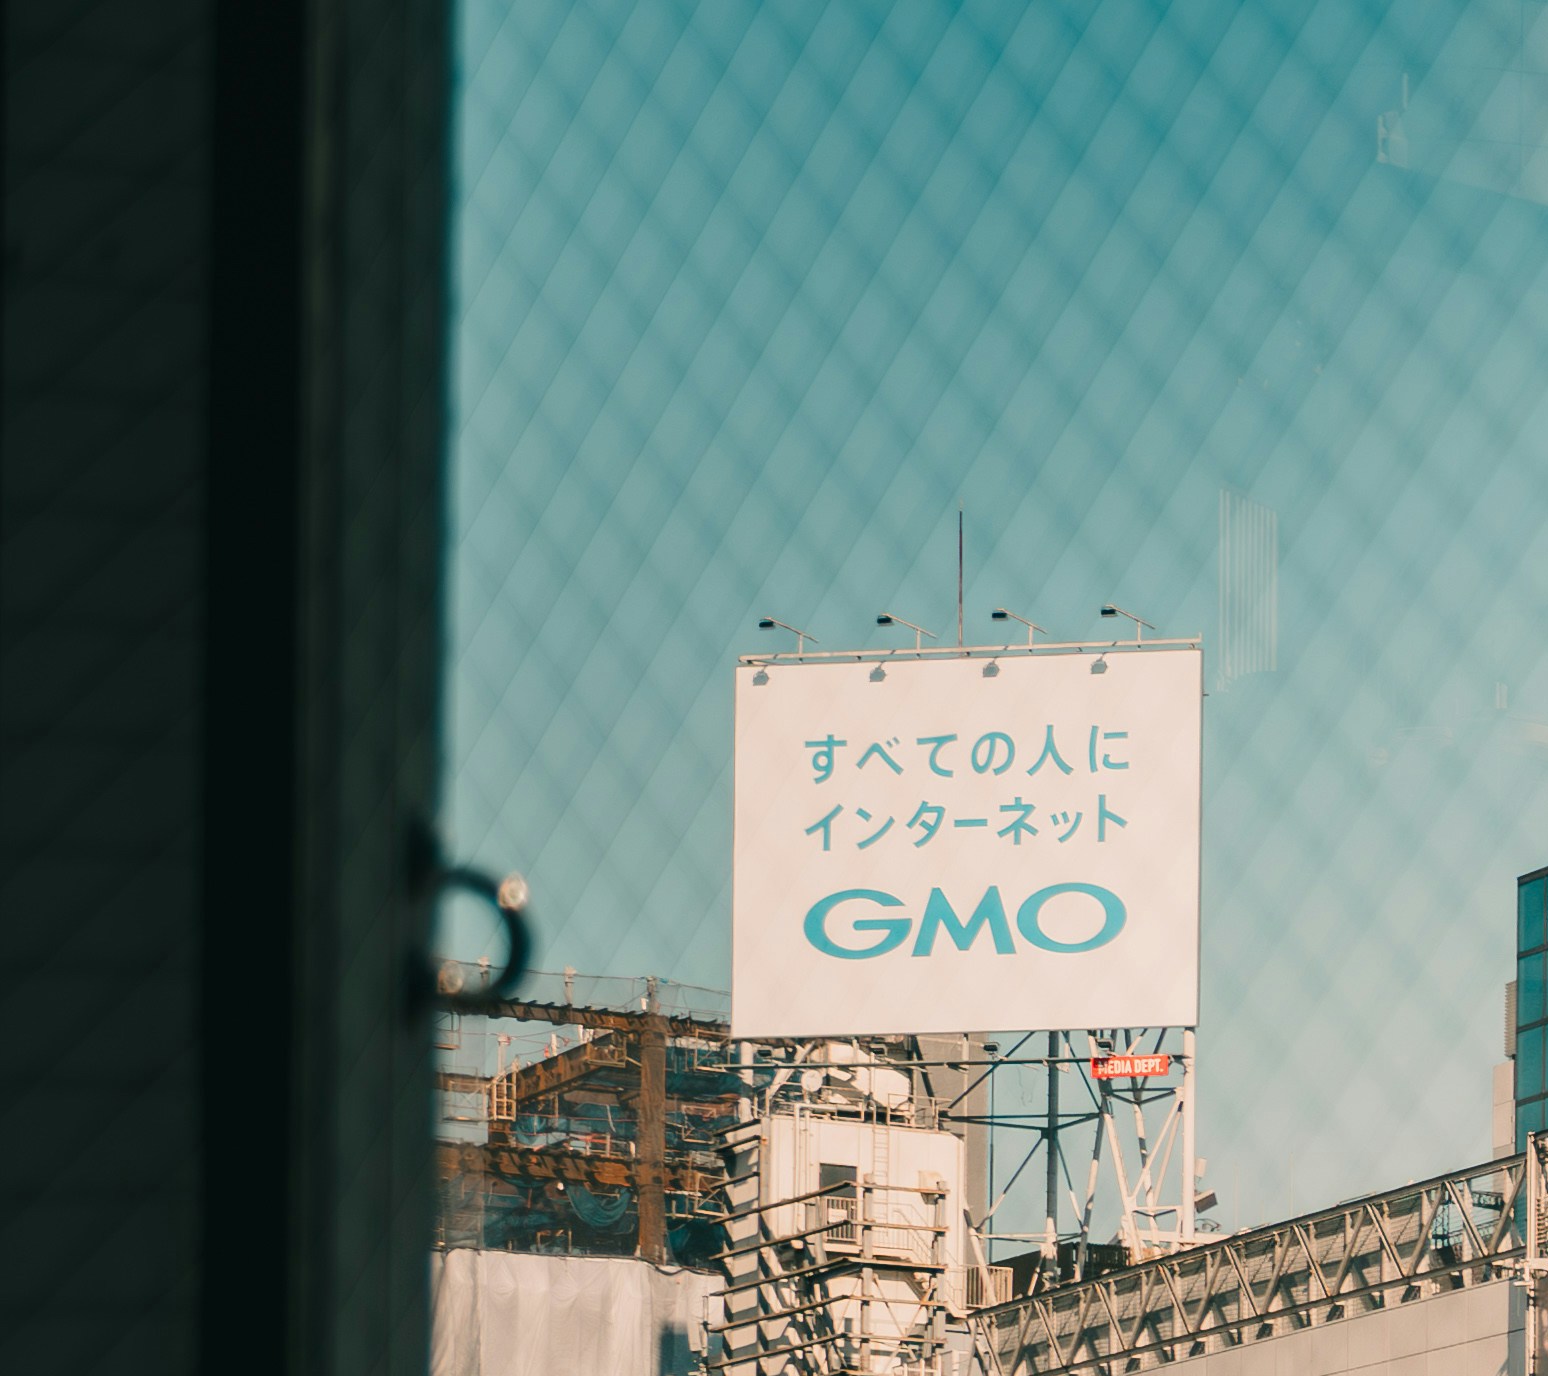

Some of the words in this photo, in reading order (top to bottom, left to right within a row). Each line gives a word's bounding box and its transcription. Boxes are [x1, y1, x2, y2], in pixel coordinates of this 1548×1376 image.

[804, 725, 1130, 783] すべての人に
[804, 796, 1128, 851] インターネット
[803, 883, 1127, 960] GMO
[1133, 1058, 1164, 1073] DEPT.
